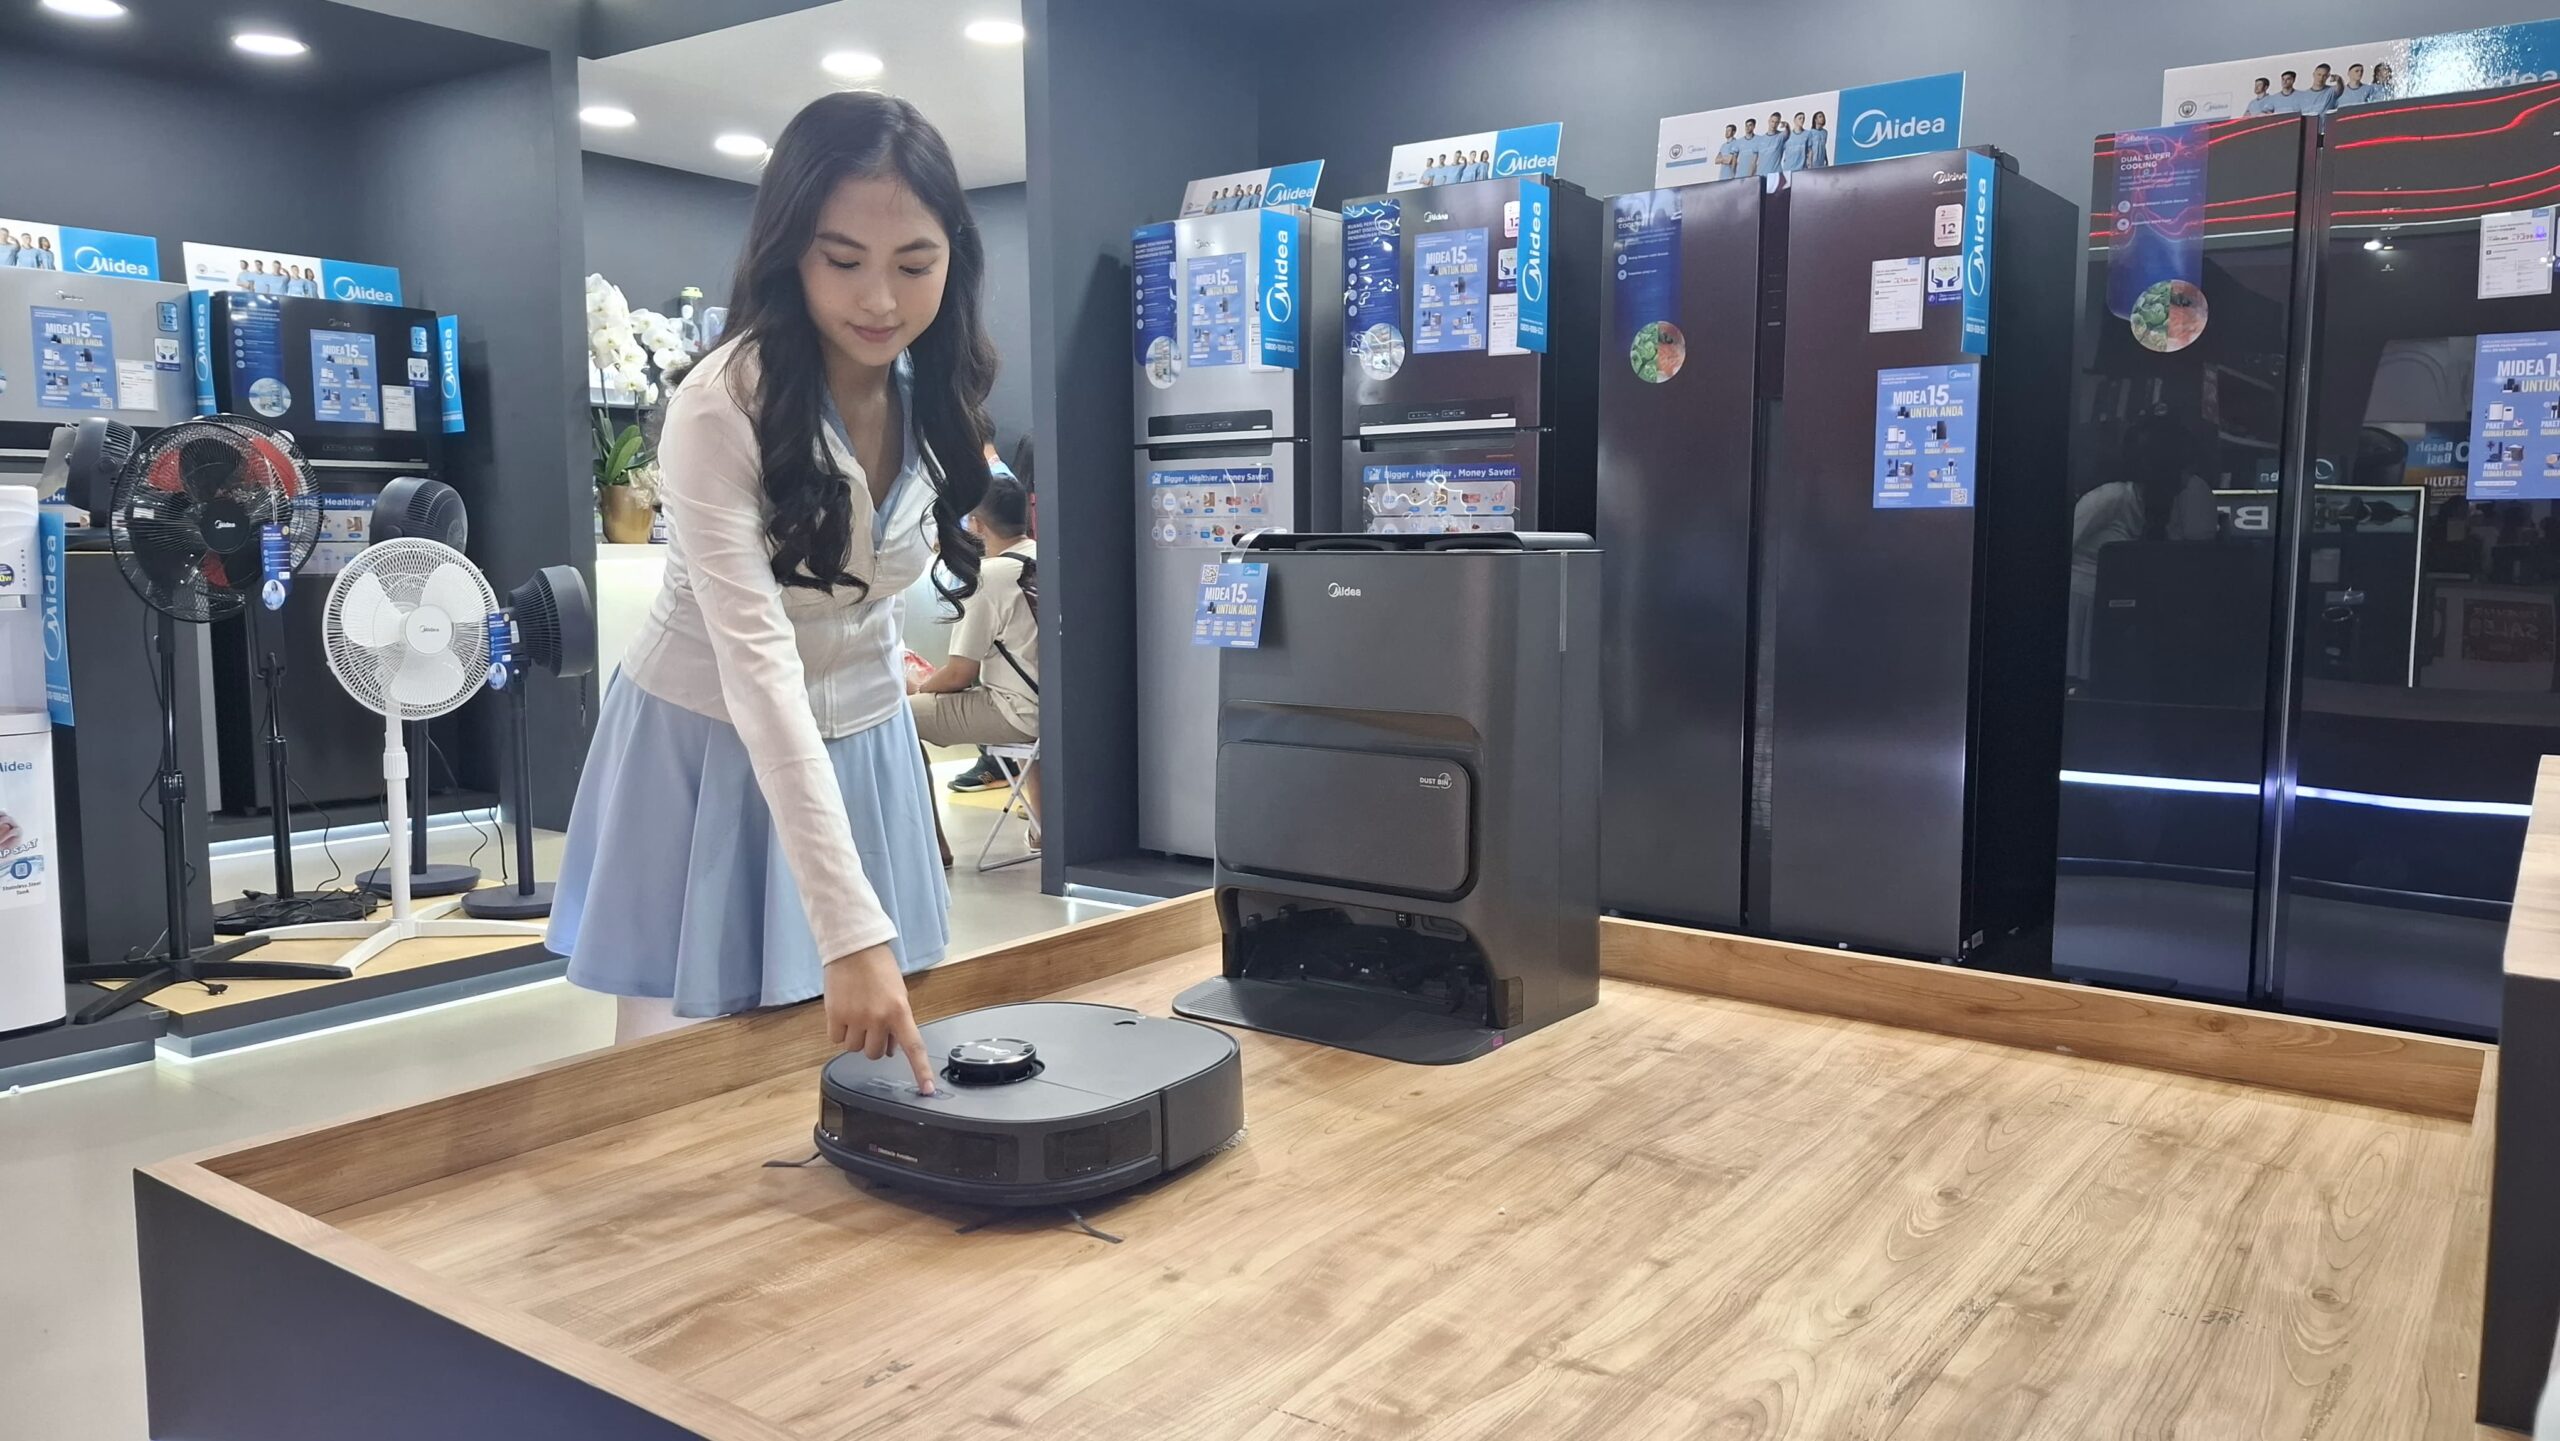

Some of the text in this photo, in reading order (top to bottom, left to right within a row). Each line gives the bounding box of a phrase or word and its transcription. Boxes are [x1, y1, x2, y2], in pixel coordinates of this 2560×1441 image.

[1851, 108, 1945, 148] Midea
[1496, 149, 1556, 175] Midea
[2121, 161, 2157, 170] COOLING
[2144, 152, 2171, 160] SUPER
[1265, 183, 1313, 206] Midea
[1941, 223, 1956, 235] 12
[1968, 178, 1986, 297] Midea
[75, 246, 148, 275] Midea
[1426, 246, 1467, 265] MIDEA 15
[1522, 202, 1542, 302] Midea
[1215, 269, 1230, 285] 15
[1266, 231, 1292, 323] Midea
[333, 276, 393, 302] Midea
[45, 322, 91, 338] MIDEA 15
[195, 303, 210, 382] Midea
[344, 344, 359, 357] 15
[442, 328, 457, 399] Midea
[2498, 353, 2560, 377] MIDEA 1
[1893, 384, 1949, 405] MIDEA 15
[1910, 406, 1963, 418] UNTUK ANDA
[1189, 473, 1218, 482] Healthier
[1223, 472, 1246, 482] Money
[1458, 468, 1486, 478] Money
[1488, 467, 1515, 477] Saver!
[325, 498, 364, 506] Healthier
[43, 535, 62, 661] Midea
[1205, 583, 1248, 603] MIDEA 15
[1328, 582, 1361, 598] Midea
[1216, 604, 1256, 616] UNTUK ANDA
[1437, 778, 1449, 786] BIN
